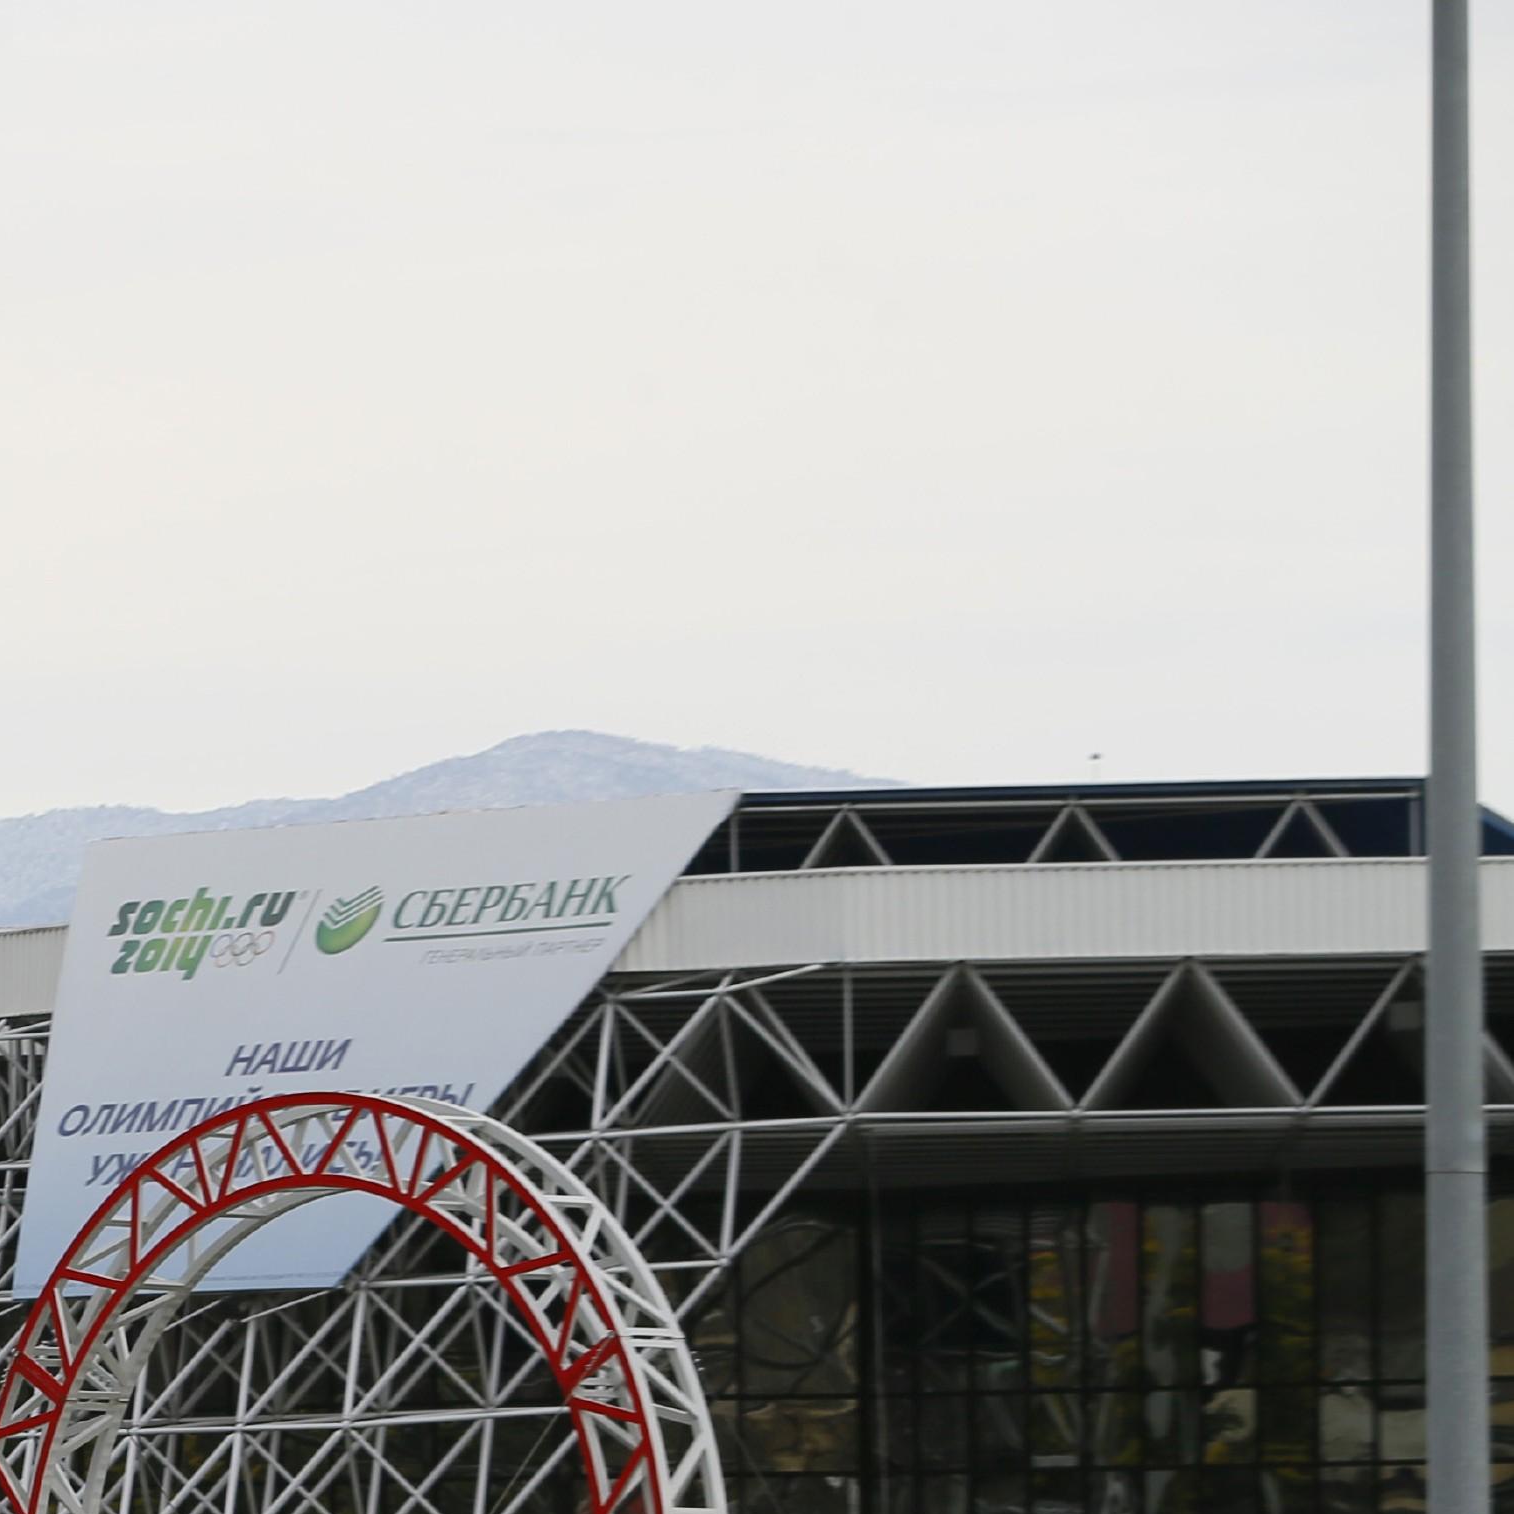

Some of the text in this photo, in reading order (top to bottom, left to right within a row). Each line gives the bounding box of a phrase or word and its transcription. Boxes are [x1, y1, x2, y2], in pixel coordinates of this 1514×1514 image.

[107, 886, 297, 937] sochi.ru
[393, 874, 633, 930] СБЕРБАНК
[110, 934, 214, 981] 2014
[223, 1038, 353, 1077] НАШИ
[57, 1086, 363, 1136] ОЛИМПИ
[85, 1152, 153, 1187] УЖ
